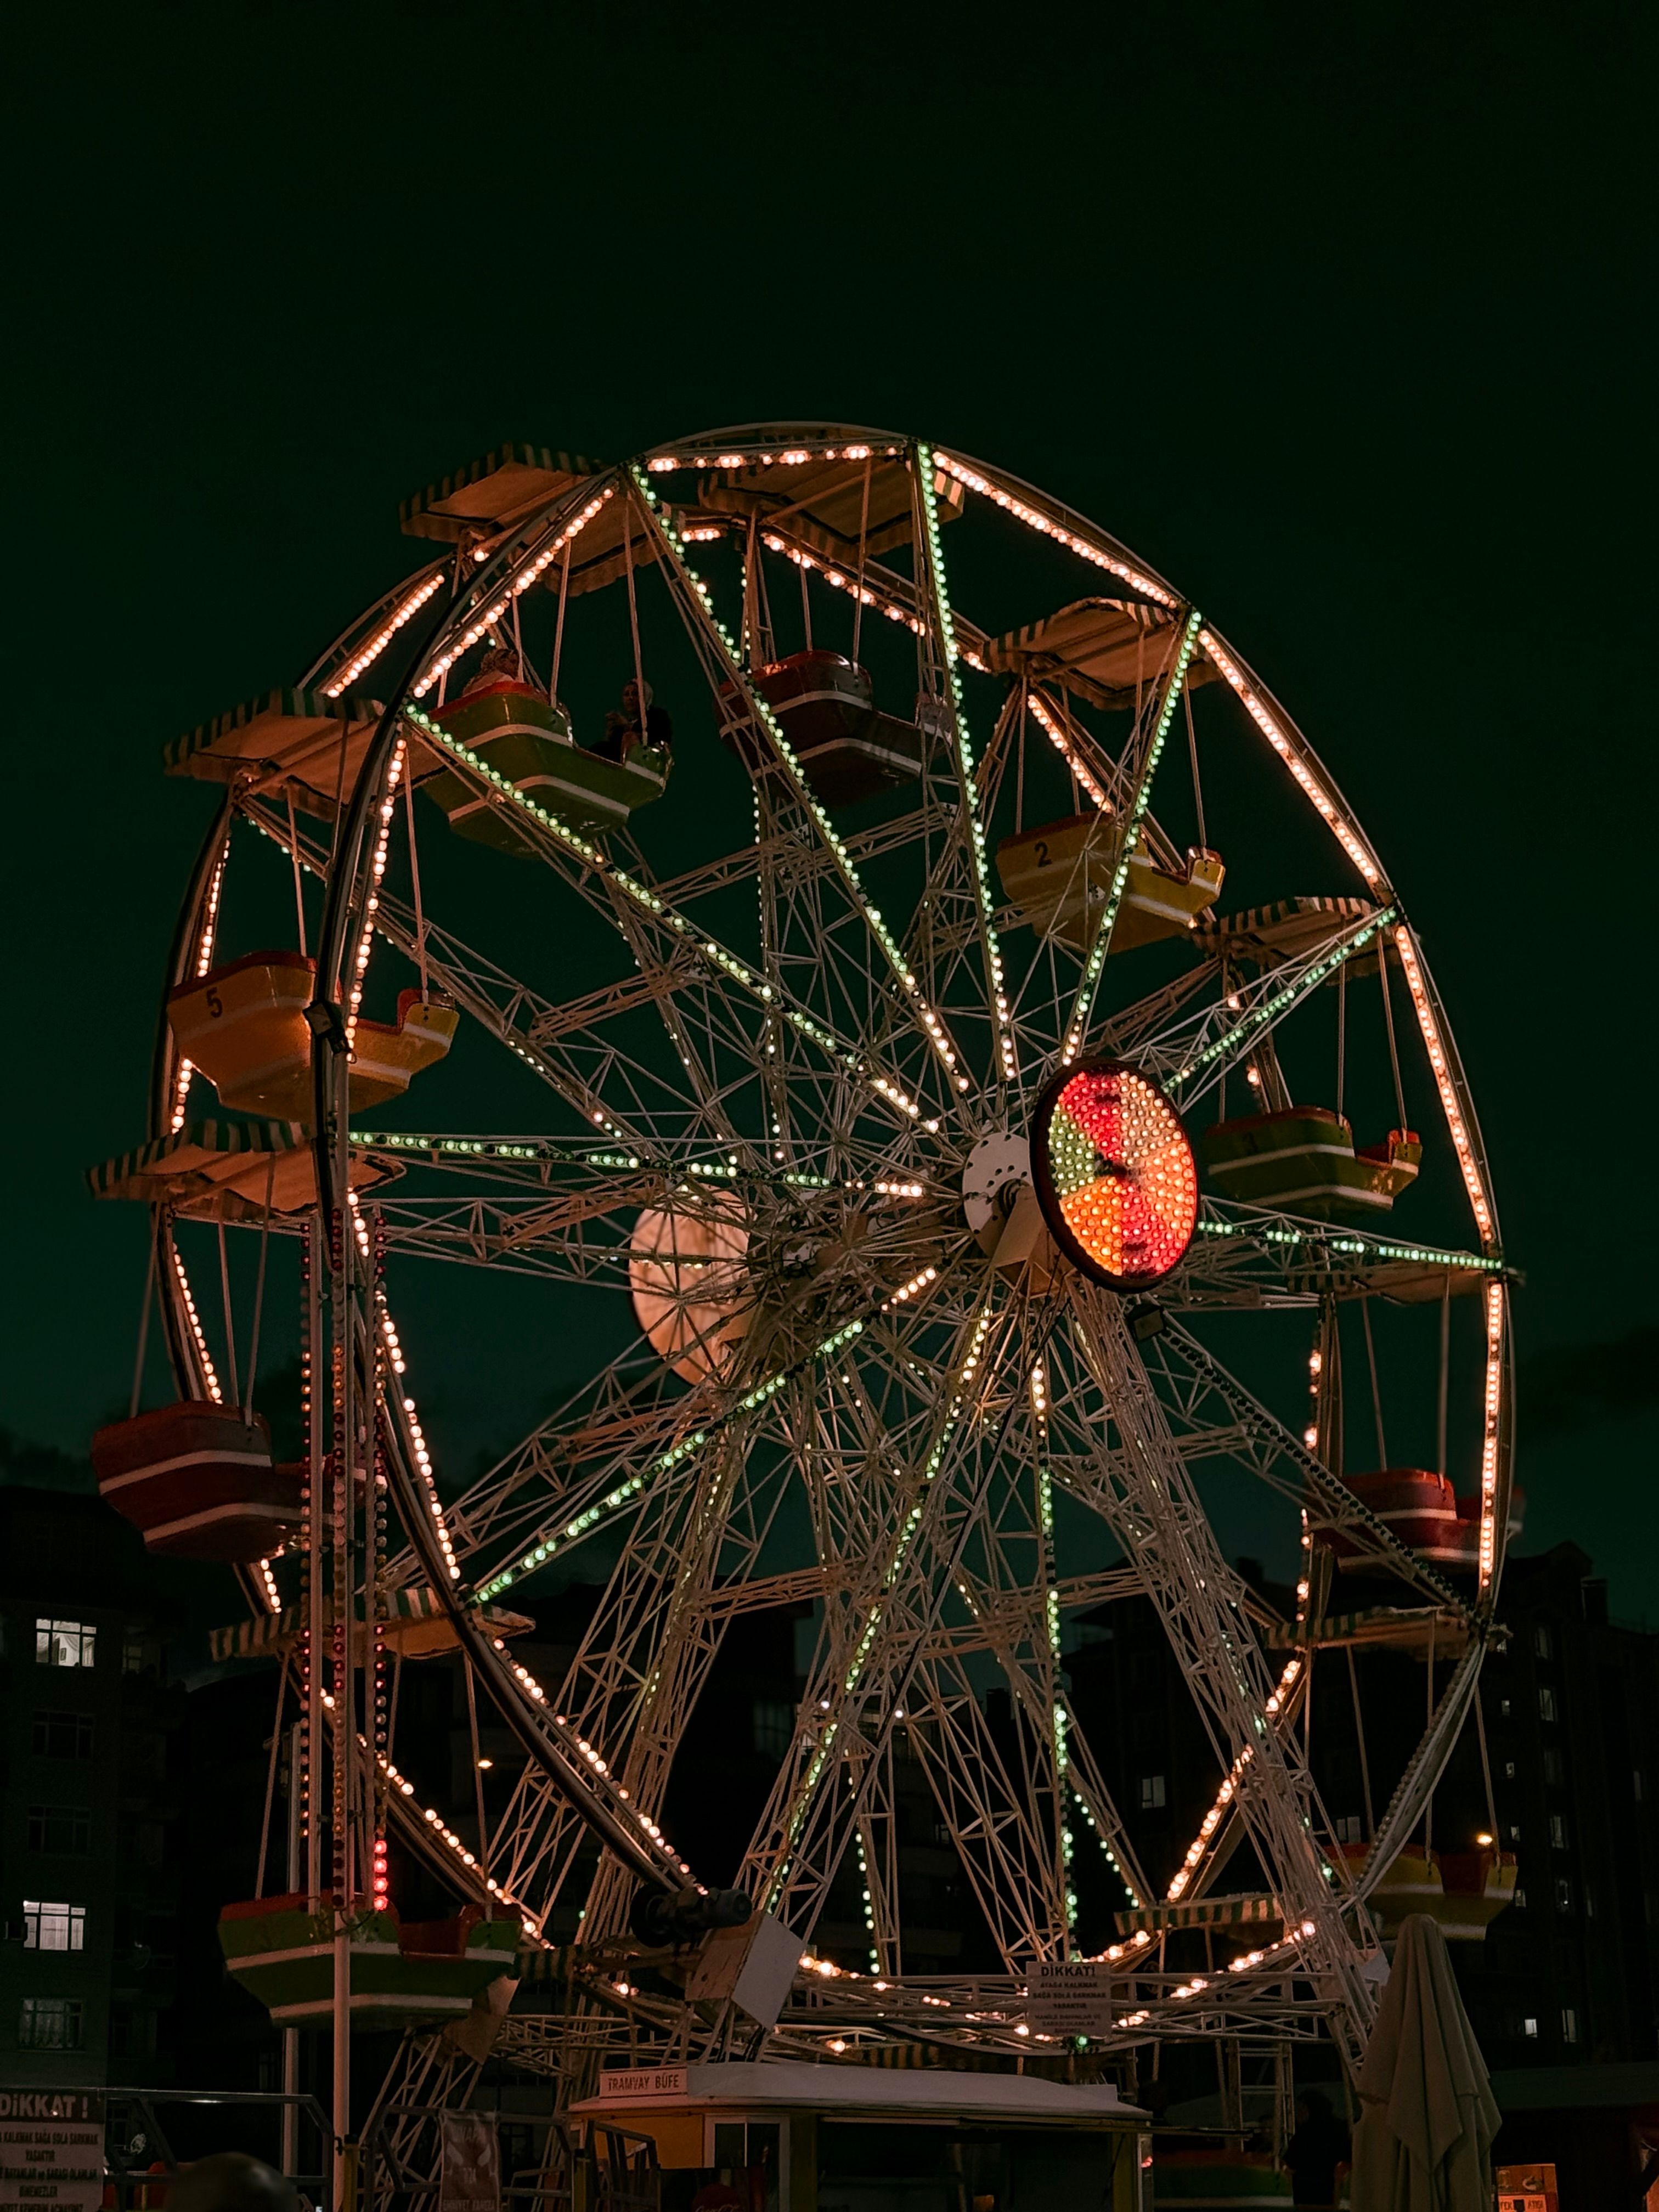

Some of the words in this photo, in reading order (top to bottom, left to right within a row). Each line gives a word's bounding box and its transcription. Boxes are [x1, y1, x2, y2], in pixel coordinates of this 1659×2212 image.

[1035, 841, 1052, 867] 2
[206, 988, 222, 1018] 5
[1041, 1964, 1096, 1976] DİKKAT!
[608, 2076, 650, 2091] TRAMVAY
[656, 2073, 679, 2089] BÜFE
